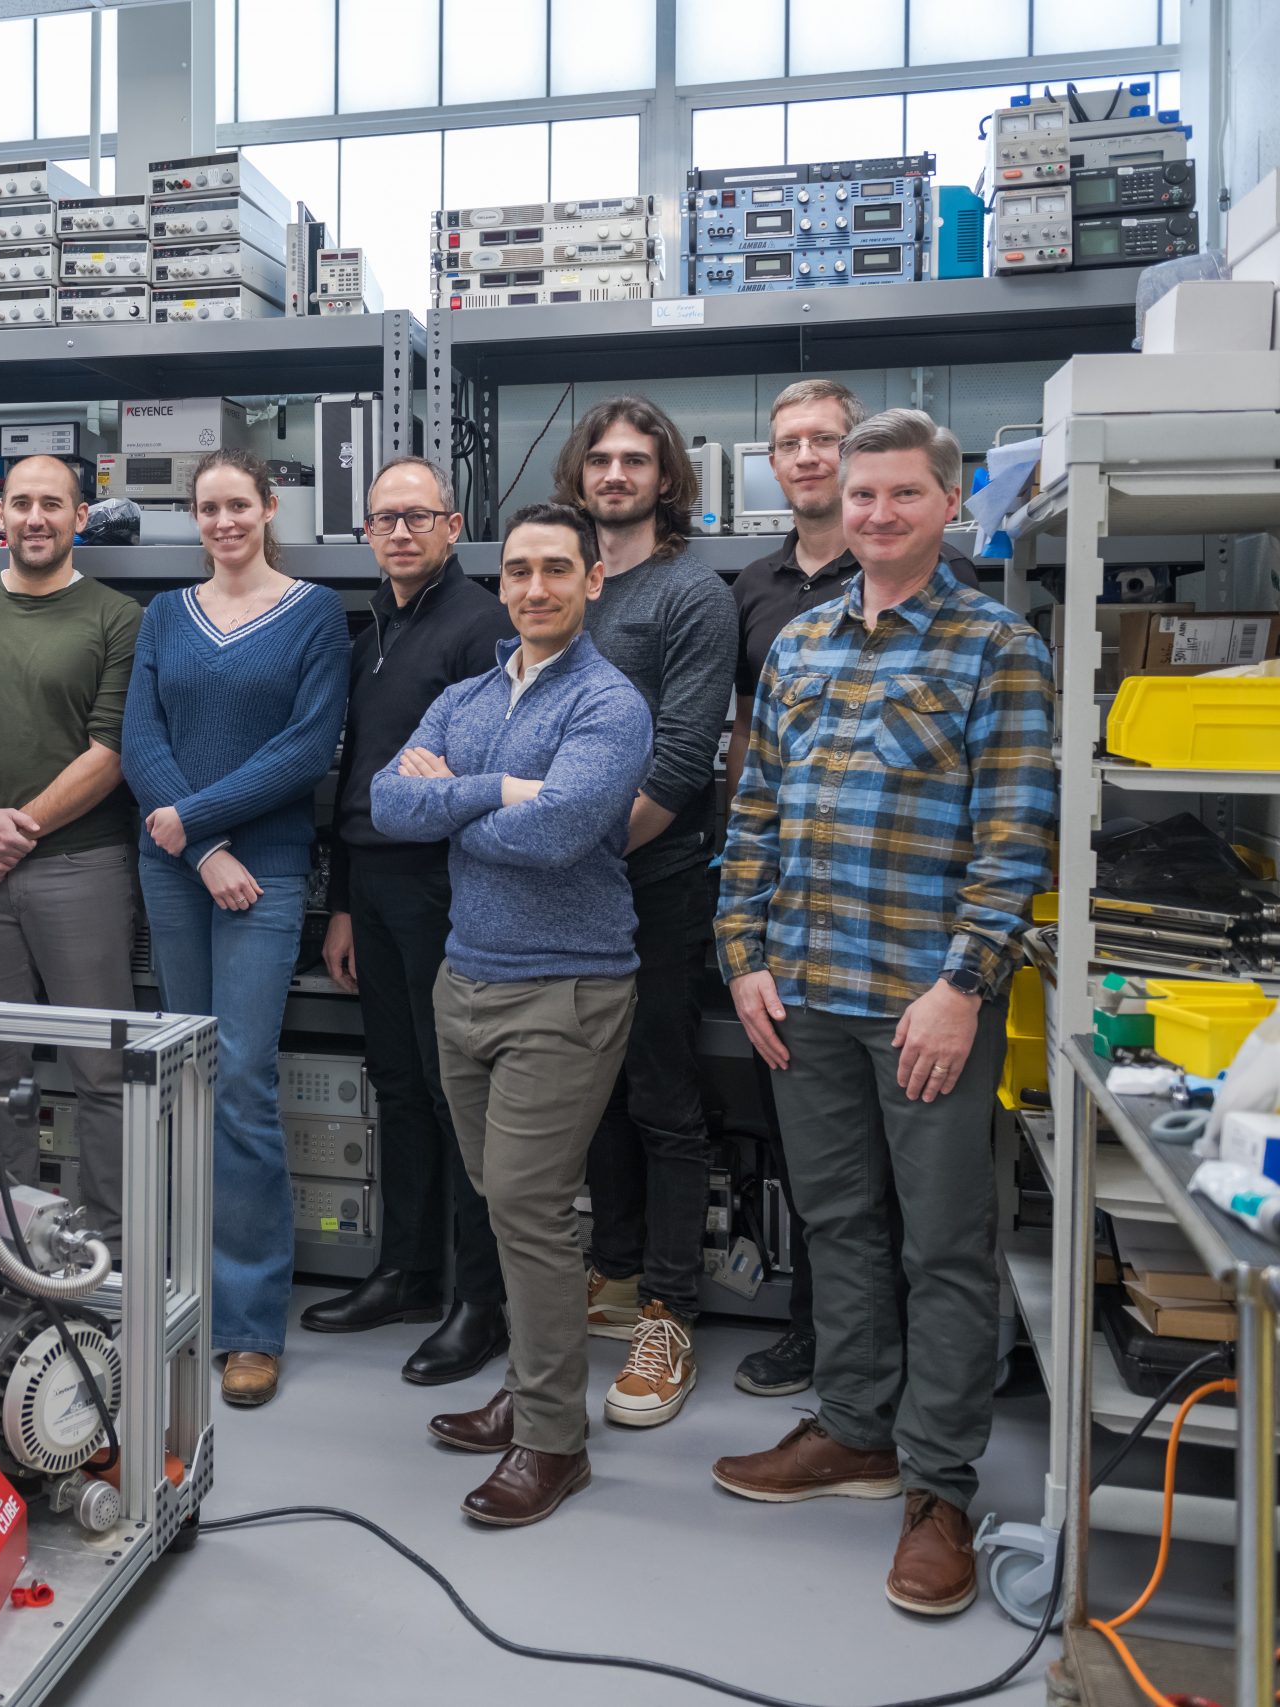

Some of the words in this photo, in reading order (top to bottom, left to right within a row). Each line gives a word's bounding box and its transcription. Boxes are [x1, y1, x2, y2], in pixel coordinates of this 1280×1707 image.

[738, 241, 768, 250] LAMBDA
[737, 283, 766, 293] LAMBDA
[126, 405, 173, 417] KEYENCE
